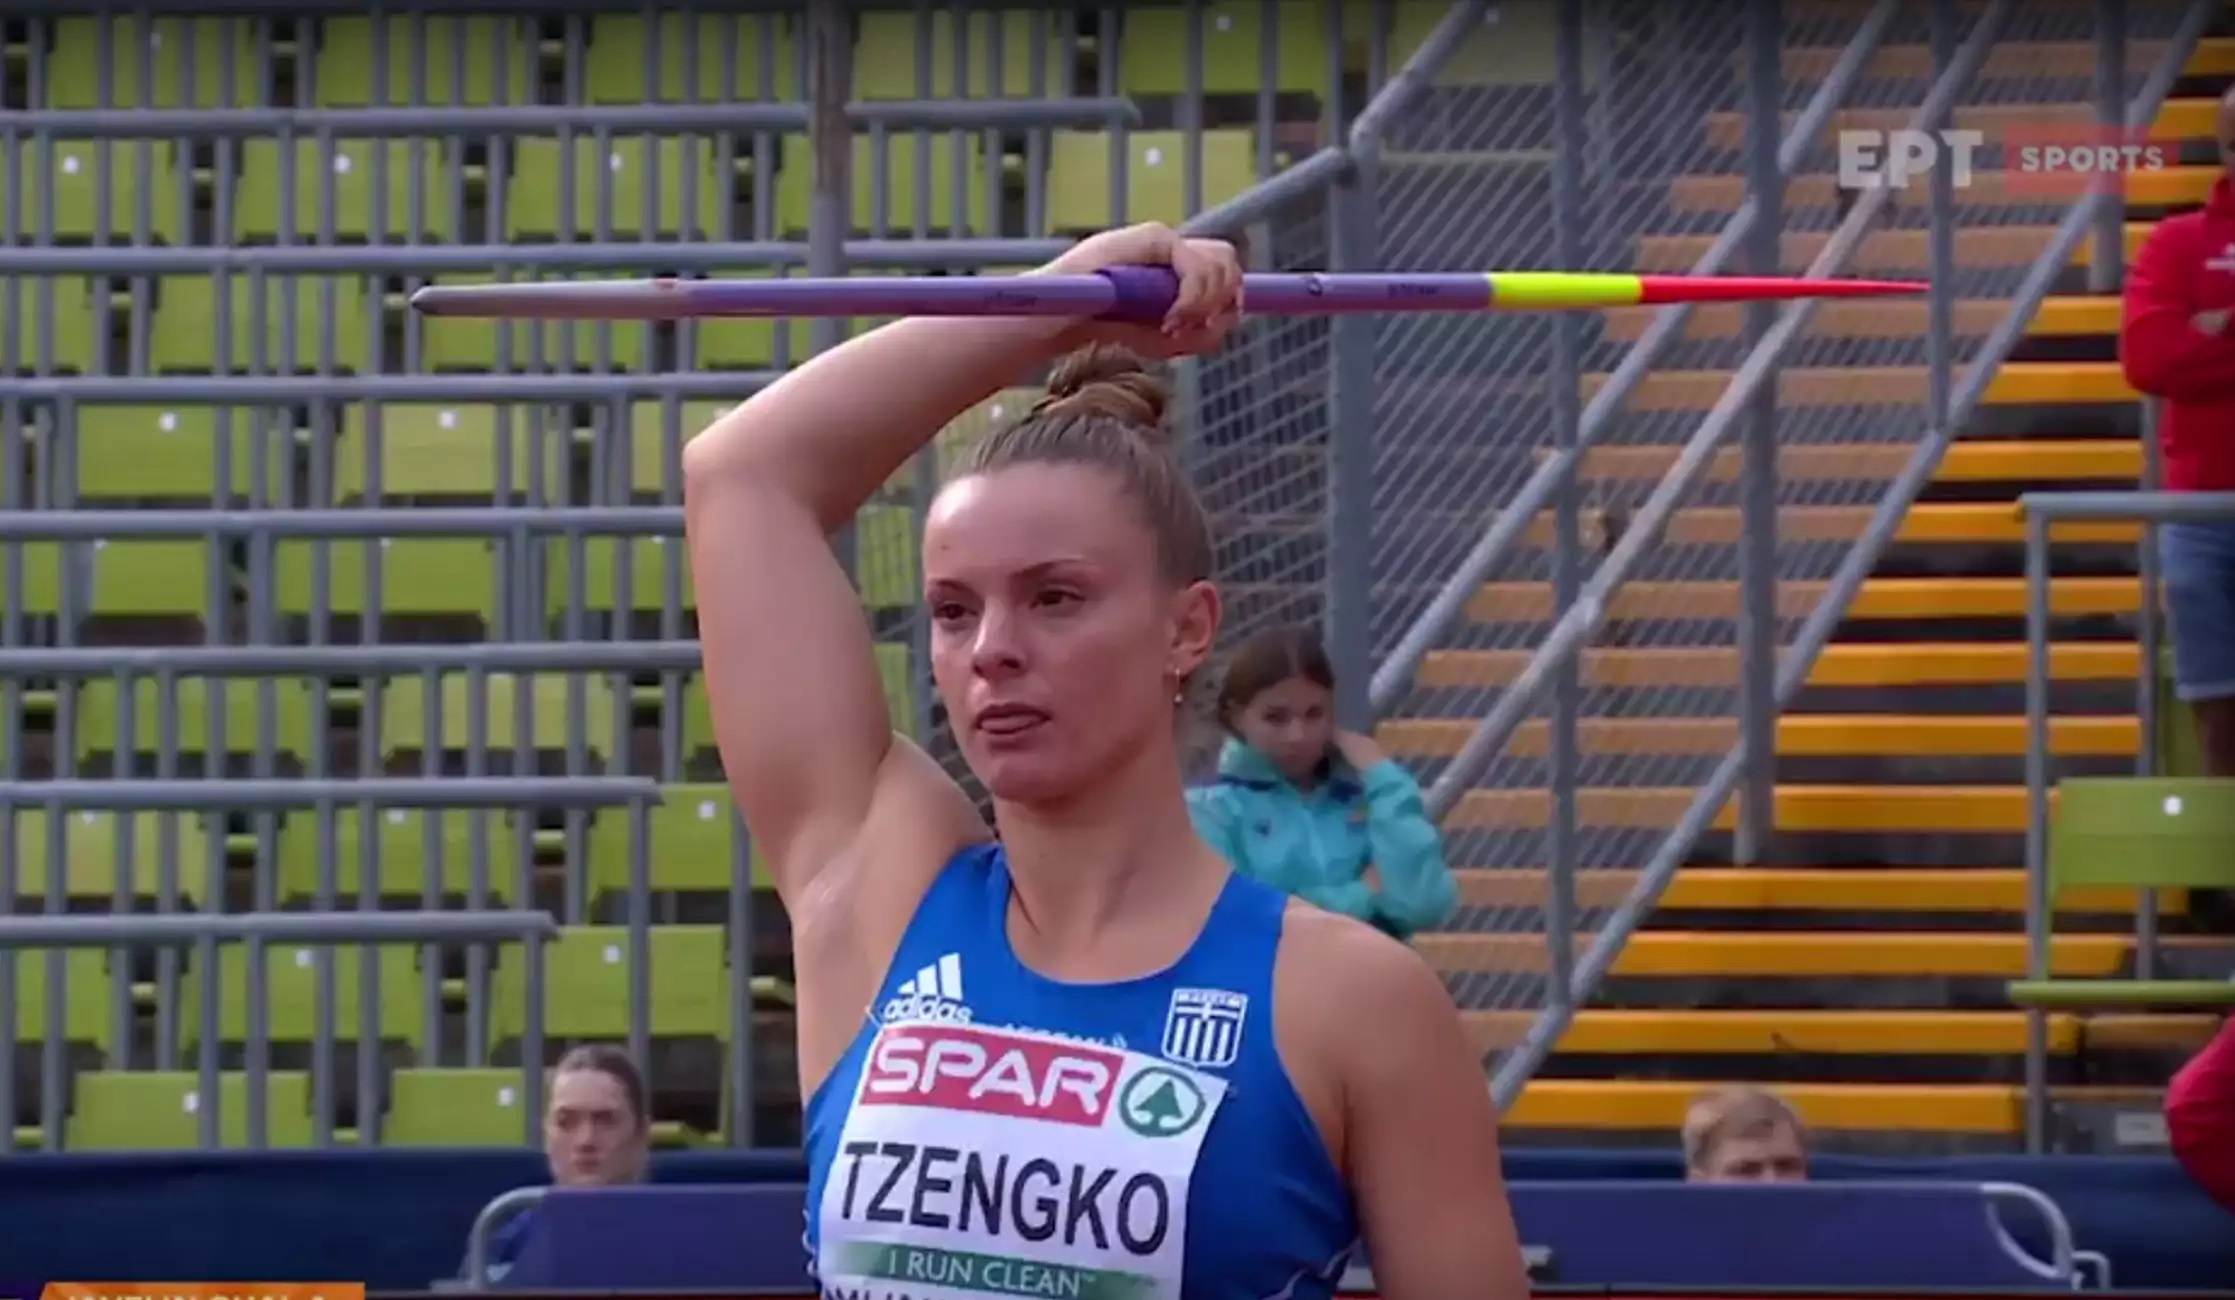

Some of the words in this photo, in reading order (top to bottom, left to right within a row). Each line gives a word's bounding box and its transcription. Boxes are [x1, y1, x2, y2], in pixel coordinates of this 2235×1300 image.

[884, 992, 973, 1023] adidas
[869, 1037, 1112, 1115] SPAR
[840, 1142, 1169, 1256] TZENGKO
[887, 1251, 897, 1275] I
[906, 1253, 974, 1284] RUN
